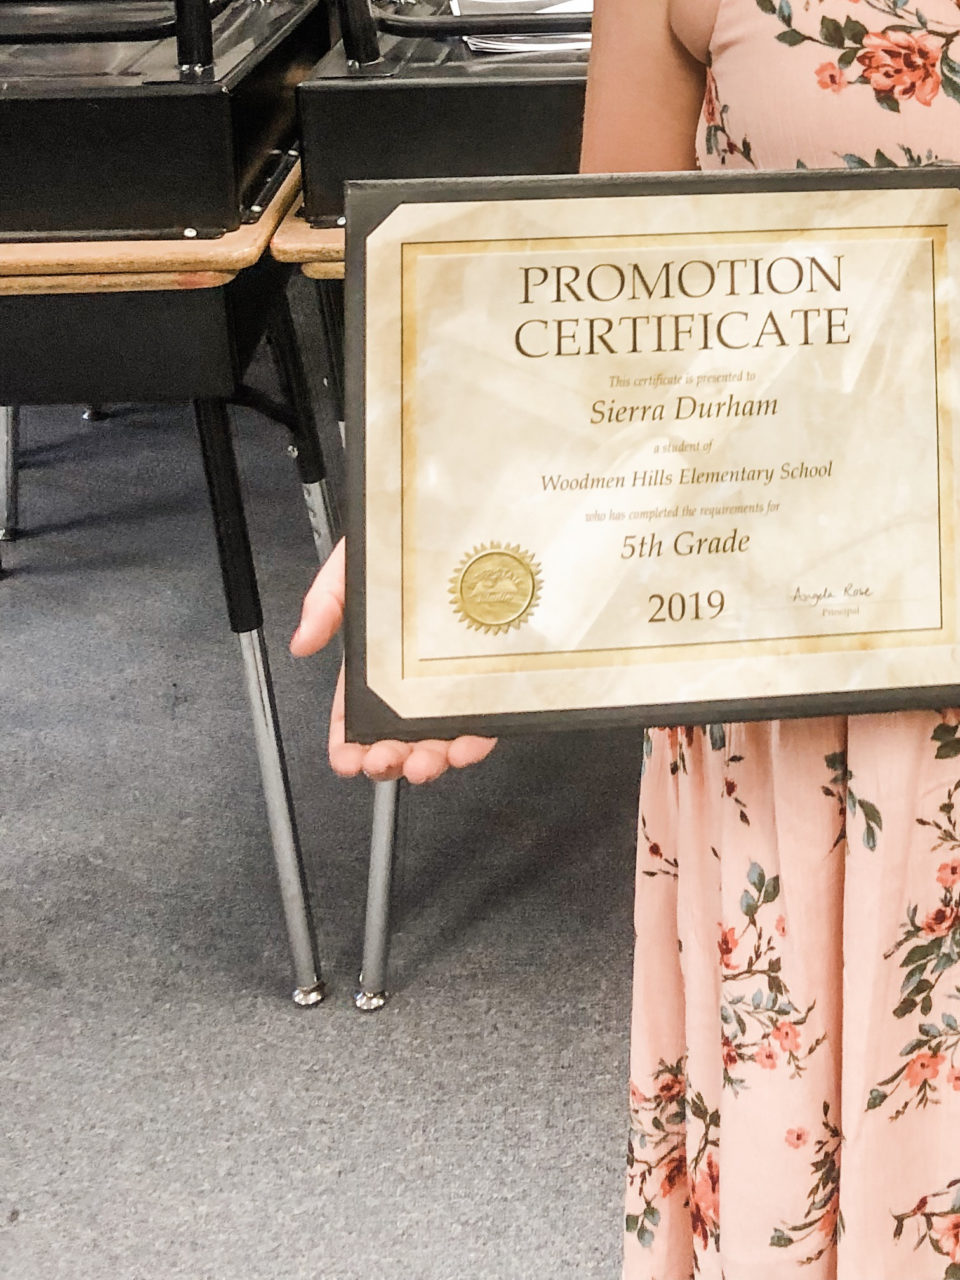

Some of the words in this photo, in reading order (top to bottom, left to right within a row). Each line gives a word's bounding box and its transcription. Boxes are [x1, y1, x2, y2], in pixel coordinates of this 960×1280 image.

[518, 255, 847, 304] PROMOTION
[514, 307, 851, 358] CERTIFICATE
[609, 375, 631, 388] This
[633, 373, 683, 389] certificate
[685, 373, 694, 385] is
[696, 371, 743, 387] presented
[746, 371, 756, 382] to
[590, 399, 665, 424] Sierra
[675, 394, 779, 421] Durham
[653, 444, 660, 454] a
[662, 441, 700, 454] student
[703, 439, 715, 455] of
[541, 473, 625, 492] Woodmen
[632, 469, 673, 488] Hills
[679, 463, 775, 486] Elementary
[780, 460, 834, 480] School
[585, 509, 607, 522] who
[608, 508, 626, 521] has
[629, 504, 679, 521] completed
[682, 504, 697, 517] the
[700, 502, 764, 519] requirements
[766, 499, 781, 513] for
[621, 533, 663, 560] 5th
[673, 528, 751, 557] Grade
[648, 590, 726, 623] 2019
